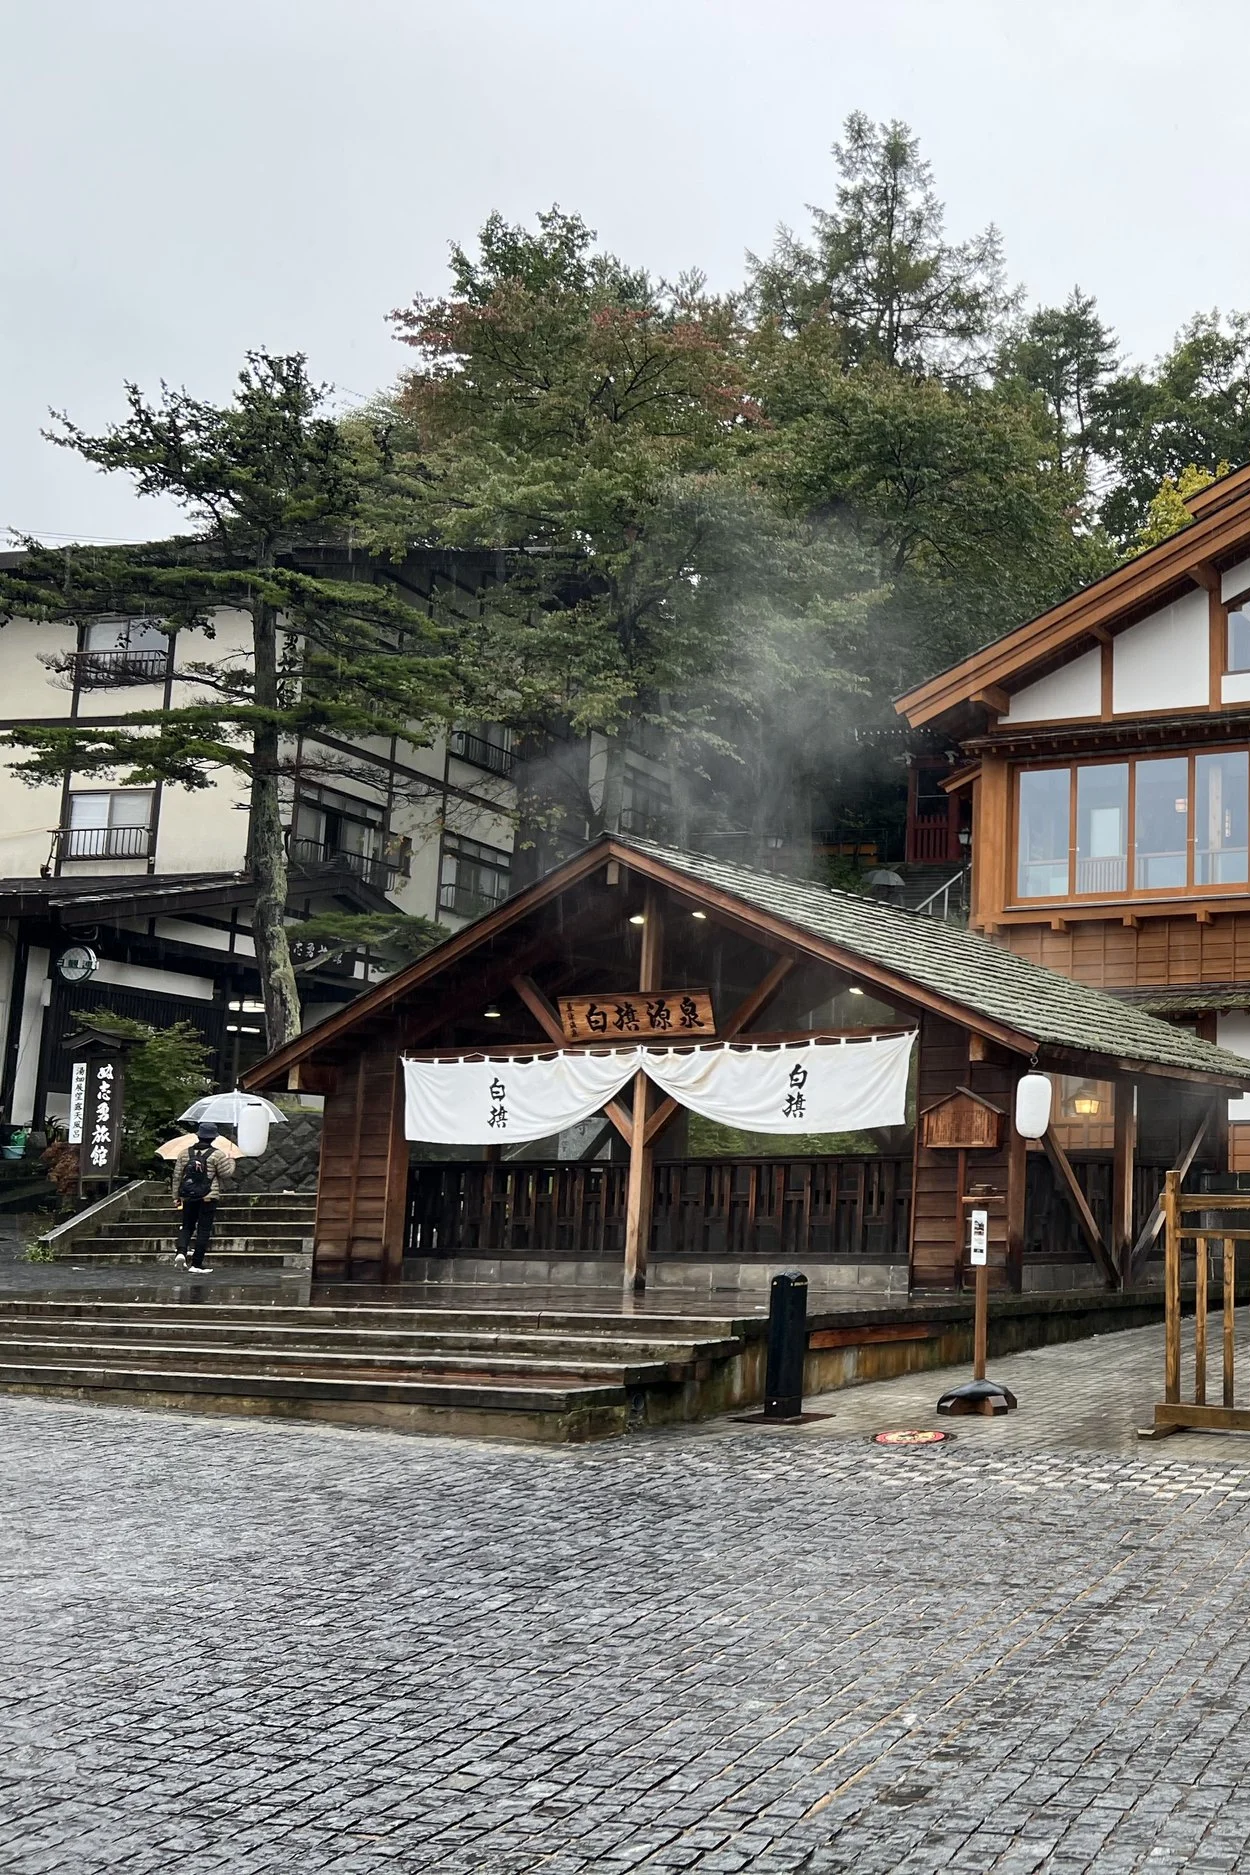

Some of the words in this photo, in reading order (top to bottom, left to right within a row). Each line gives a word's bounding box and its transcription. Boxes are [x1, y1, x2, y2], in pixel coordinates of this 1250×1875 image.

[585, 996, 705, 1034] 白旗源泉
[487, 1077, 508, 1128] 白旗
[781, 1063, 808, 1118] 白旗
